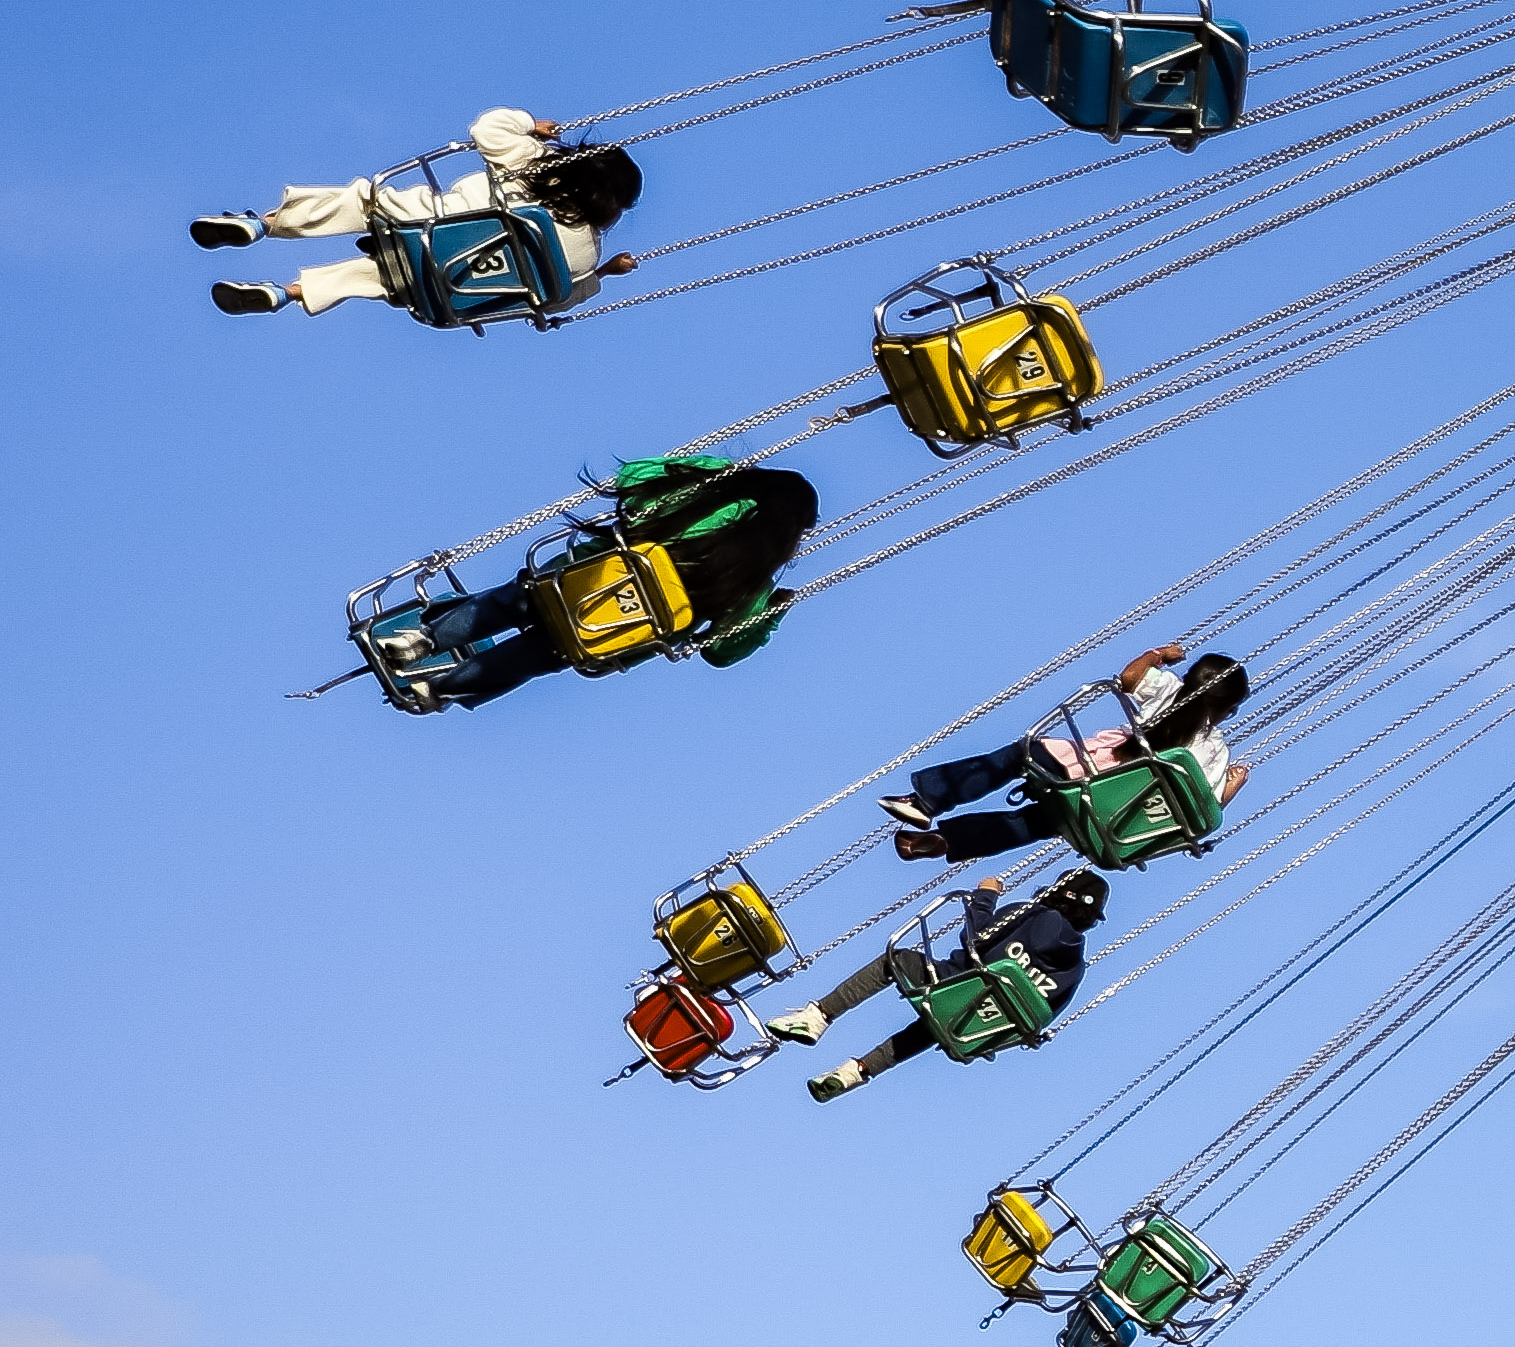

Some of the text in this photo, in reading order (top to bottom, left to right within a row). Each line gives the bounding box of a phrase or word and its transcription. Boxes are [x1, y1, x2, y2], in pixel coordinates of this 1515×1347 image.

[1014, 350, 1046, 382] 29
[616, 589, 641, 615] 23
[1143, 796, 1172, 820] 37
[713, 923, 739, 949] 26
